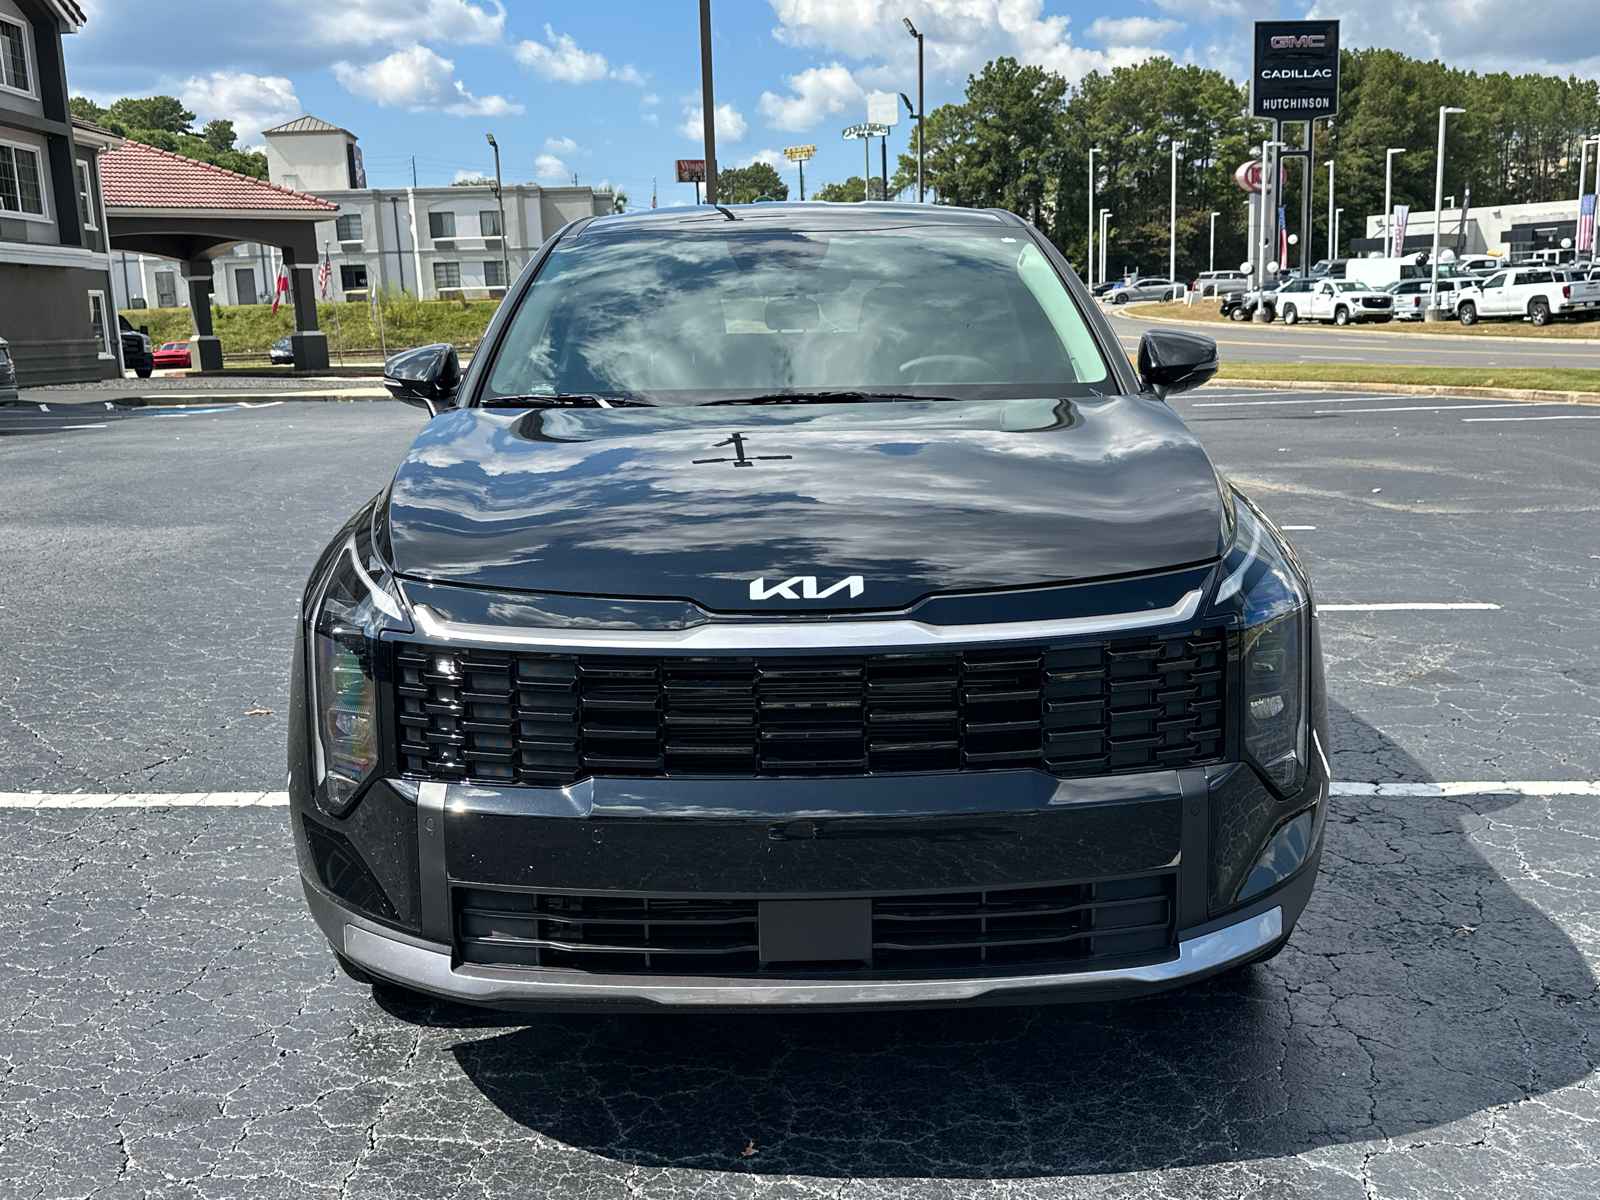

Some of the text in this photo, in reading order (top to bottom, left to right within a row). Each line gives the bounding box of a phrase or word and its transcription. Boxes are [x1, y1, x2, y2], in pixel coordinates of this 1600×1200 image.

[1270, 35, 1326, 49] GMC
[1261, 68, 1333, 79] CADILLAC
[1263, 97, 1330, 110] HUTCHINSON
[749, 575, 864, 600] KIA
